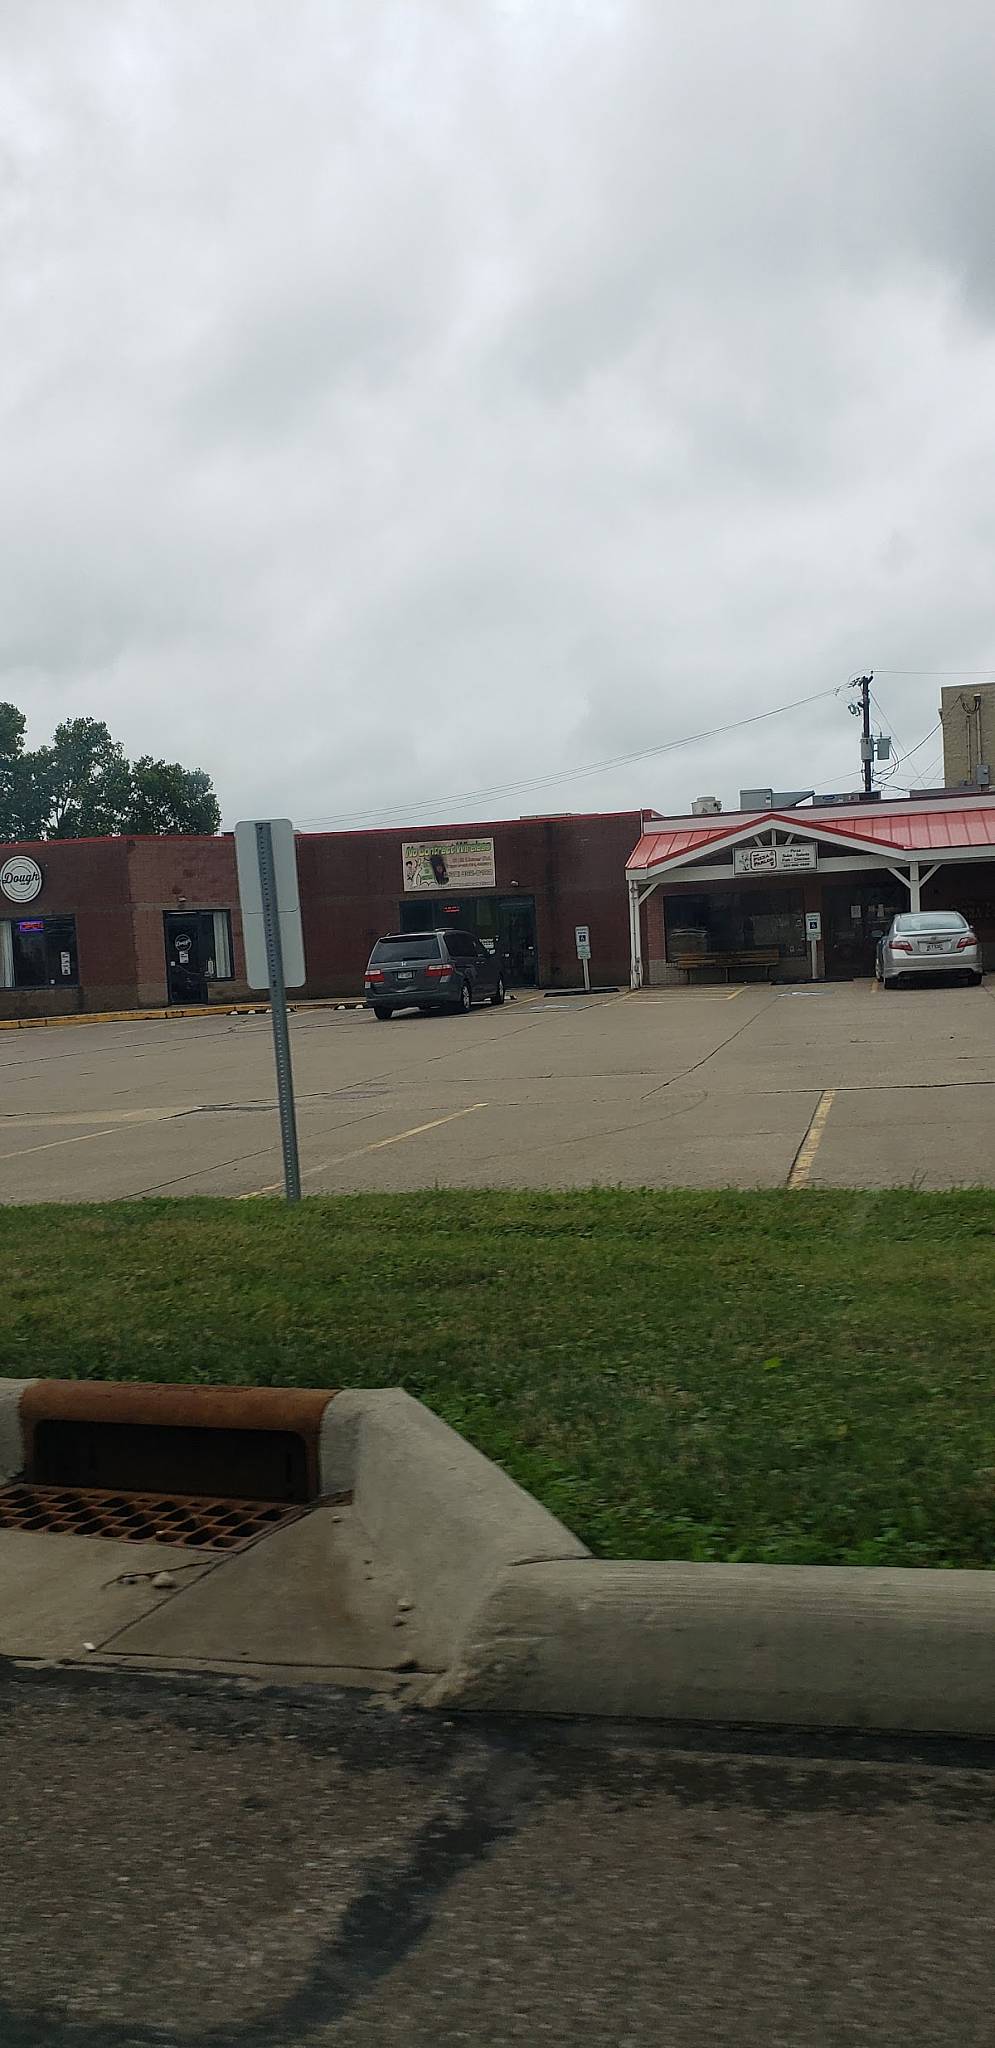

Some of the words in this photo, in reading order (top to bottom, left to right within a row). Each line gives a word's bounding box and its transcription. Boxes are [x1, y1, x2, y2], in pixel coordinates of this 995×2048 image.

[405, 846, 417, 858] No
[418, 844, 456, 857] Contract
[455, 841, 491, 853] Wireless
[2, 871, 40, 885] Dough
